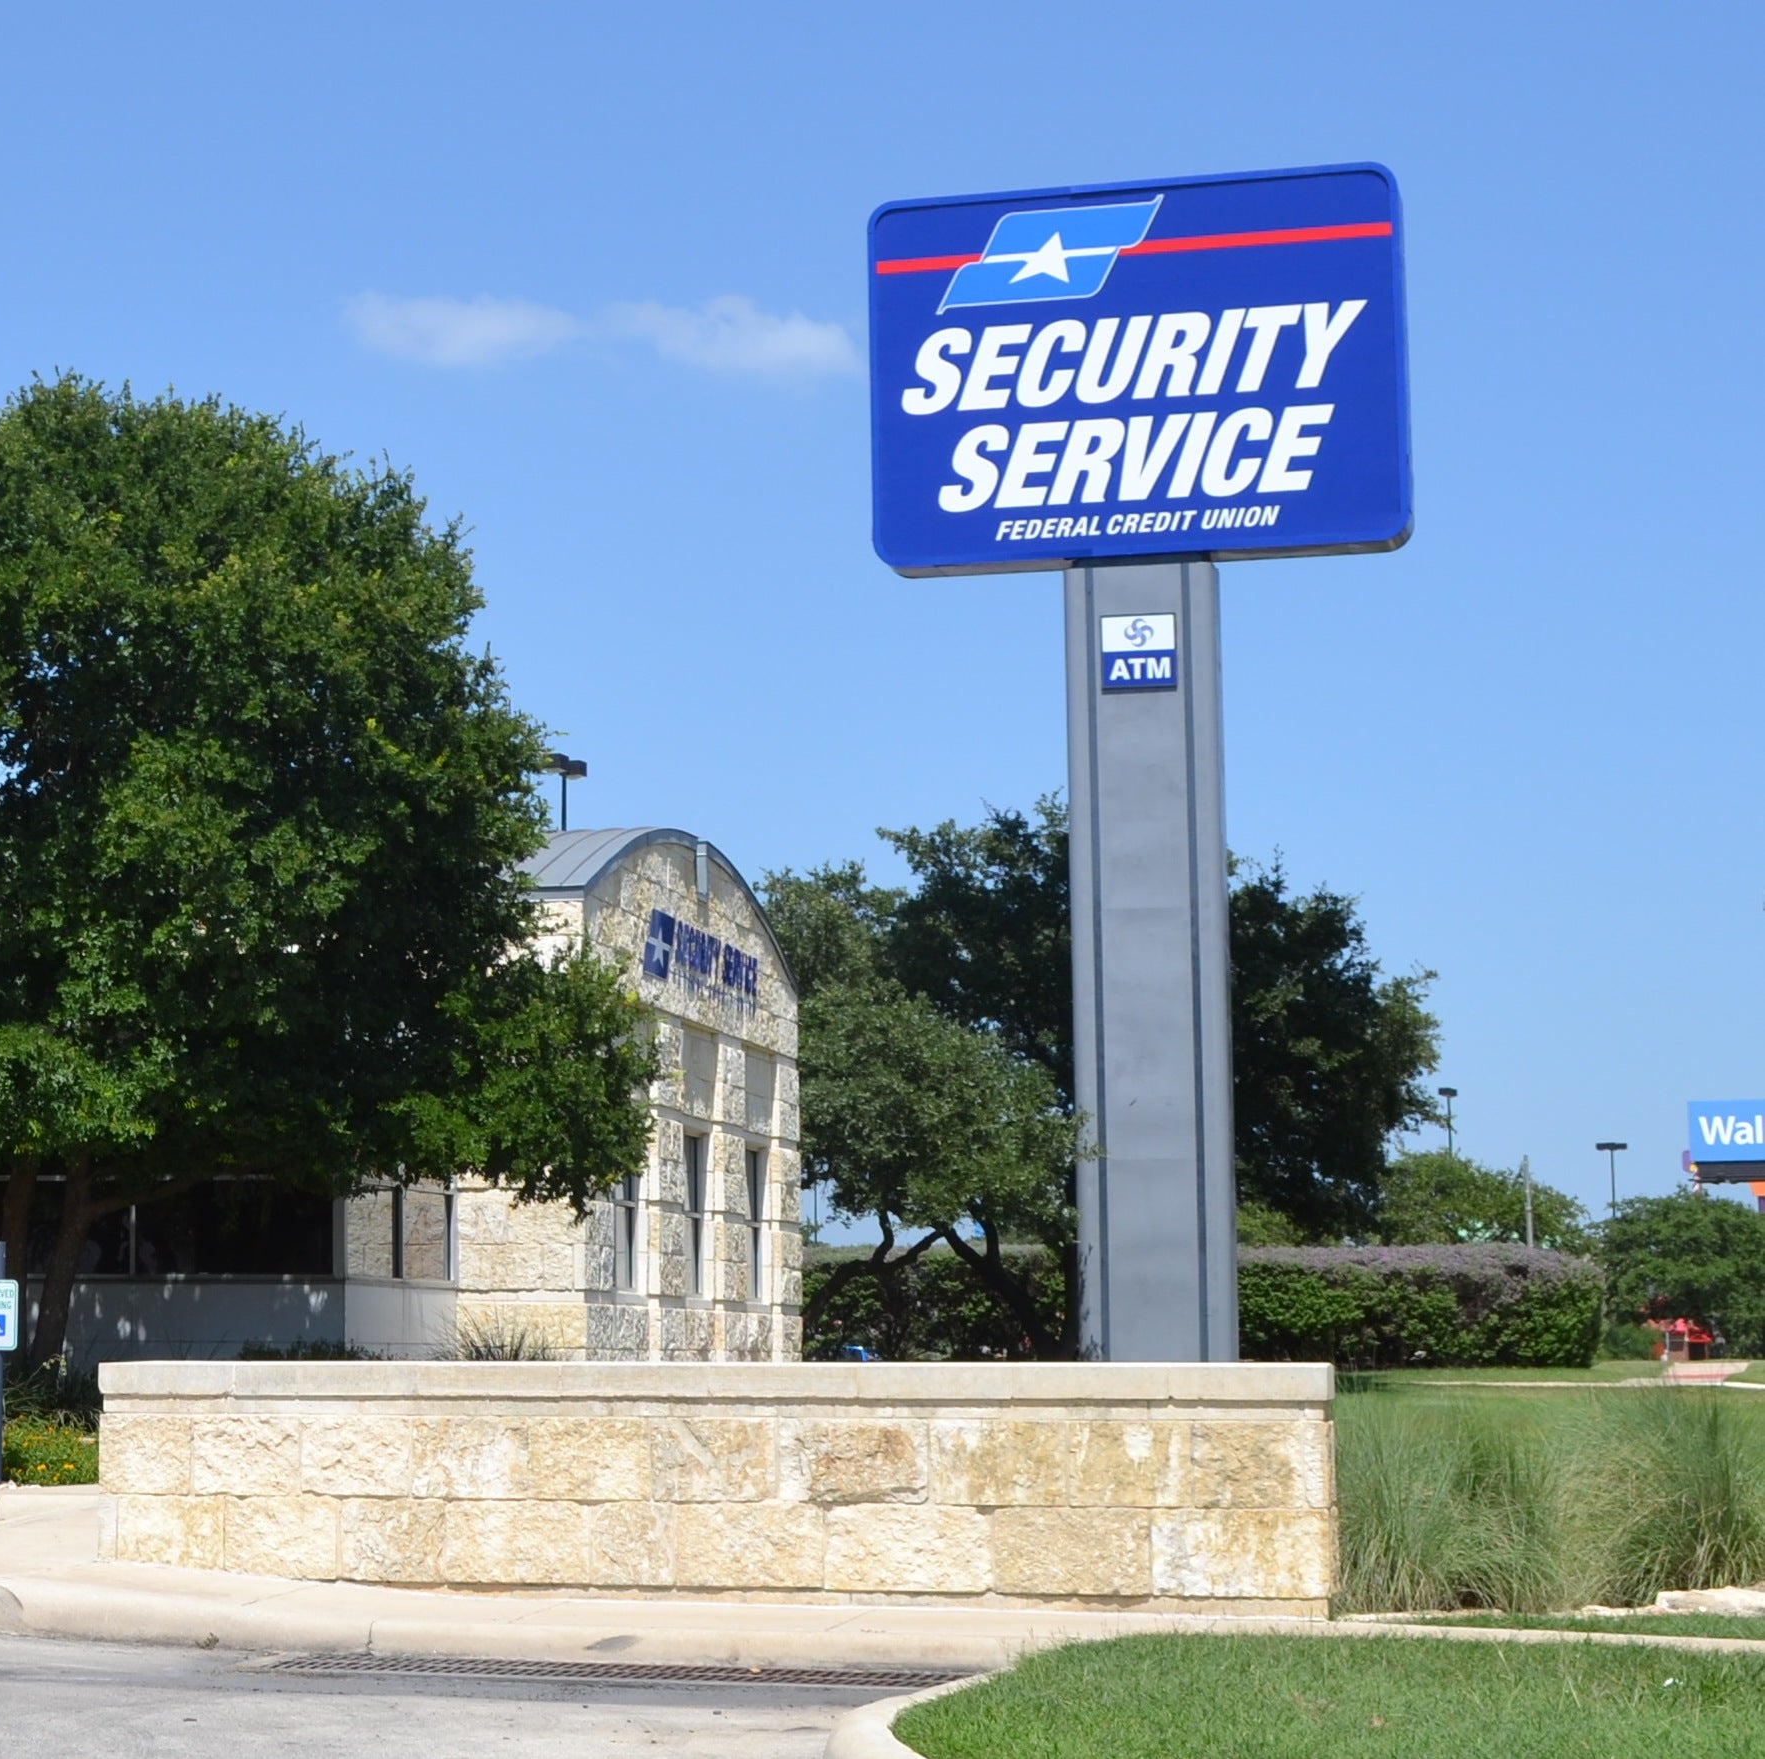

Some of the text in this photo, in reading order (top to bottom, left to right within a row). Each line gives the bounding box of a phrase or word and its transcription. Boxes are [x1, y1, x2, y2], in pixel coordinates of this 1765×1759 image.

[901, 299, 1368, 416] SECURITY
[937, 403, 1335, 513] SERVICE
[995, 505, 1281, 541] FEDERAL CREDIT UNION
[1108, 656, 1172, 681] ATM
